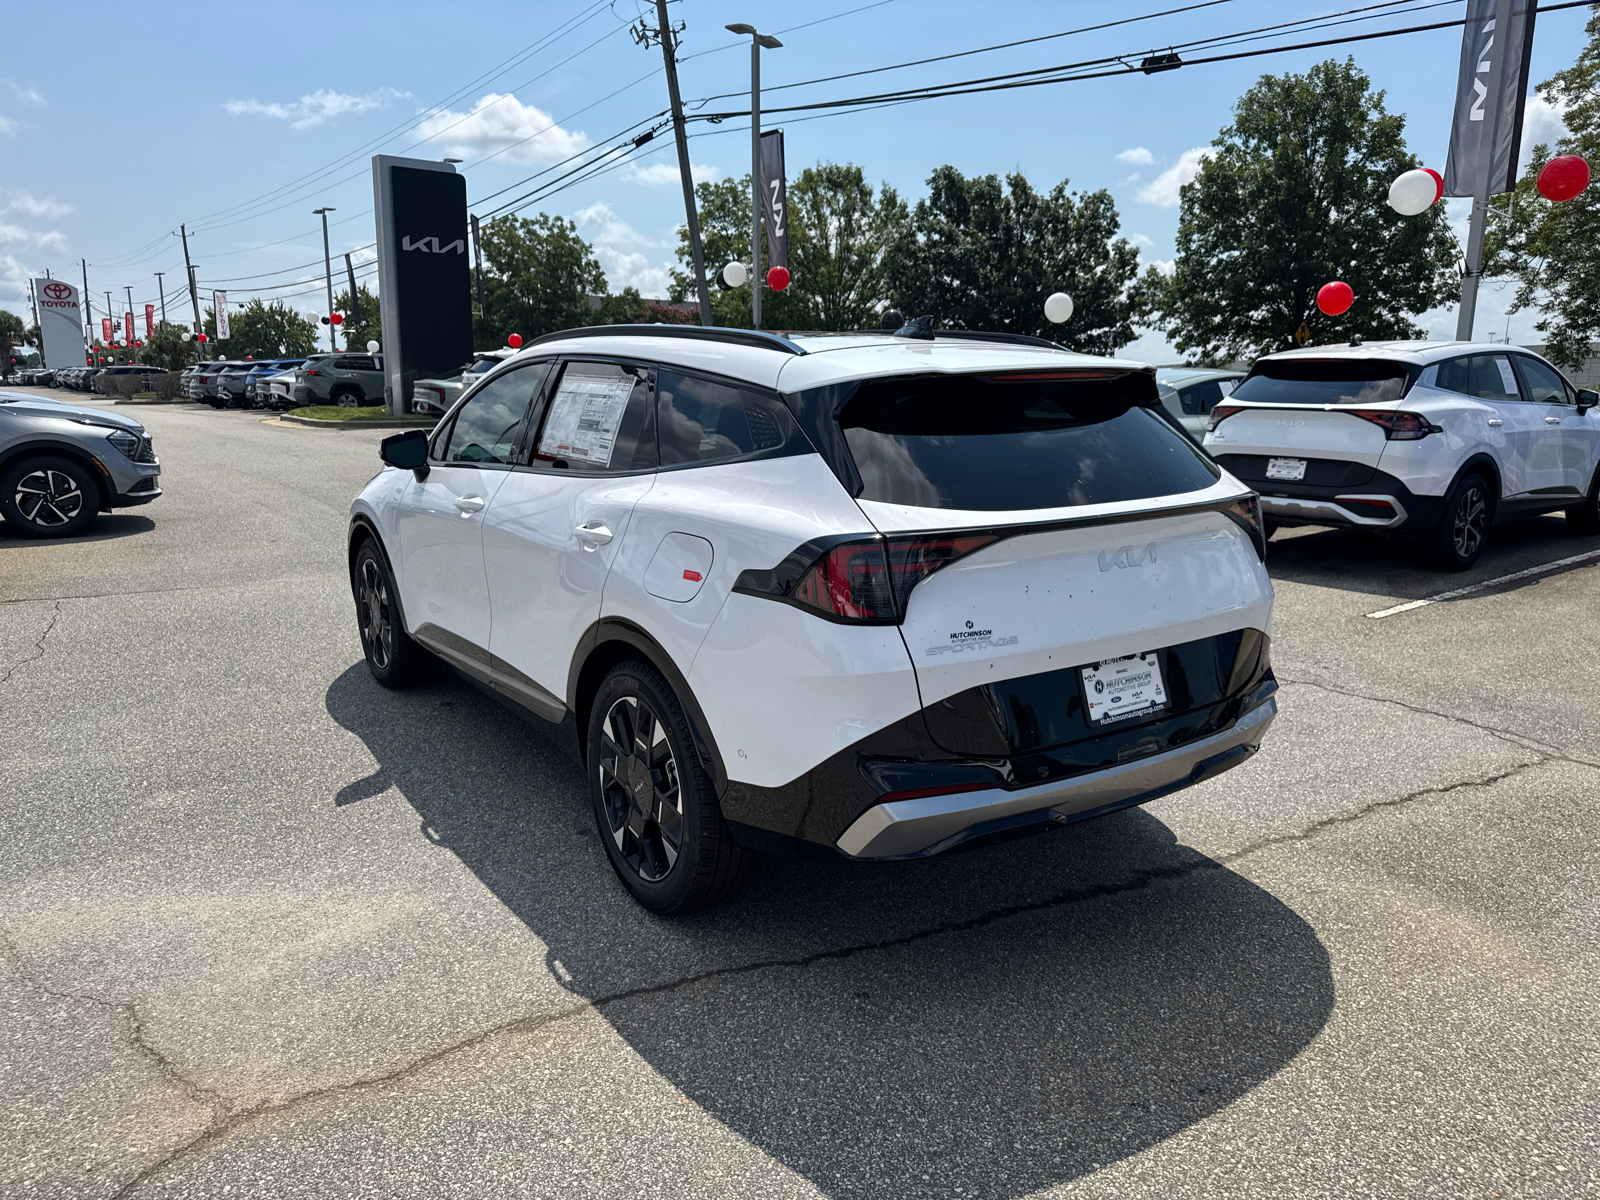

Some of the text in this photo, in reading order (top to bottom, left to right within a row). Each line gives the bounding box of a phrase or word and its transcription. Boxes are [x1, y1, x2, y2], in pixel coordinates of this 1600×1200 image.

[402, 234, 464, 255] KIA
[40, 300, 78, 308] TOYOTA
[1097, 542, 1157, 572] KIA
[950, 629, 992, 639] HUTCHINSON
[925, 635, 1018, 656] SPORTAGE
[1106, 672, 1151, 689] HUTCHINSON
[1108, 680, 1151, 695] AUTOMOTIVE GROUP
[1100, 704, 1165, 725] Hutchinsonautogroup.com
